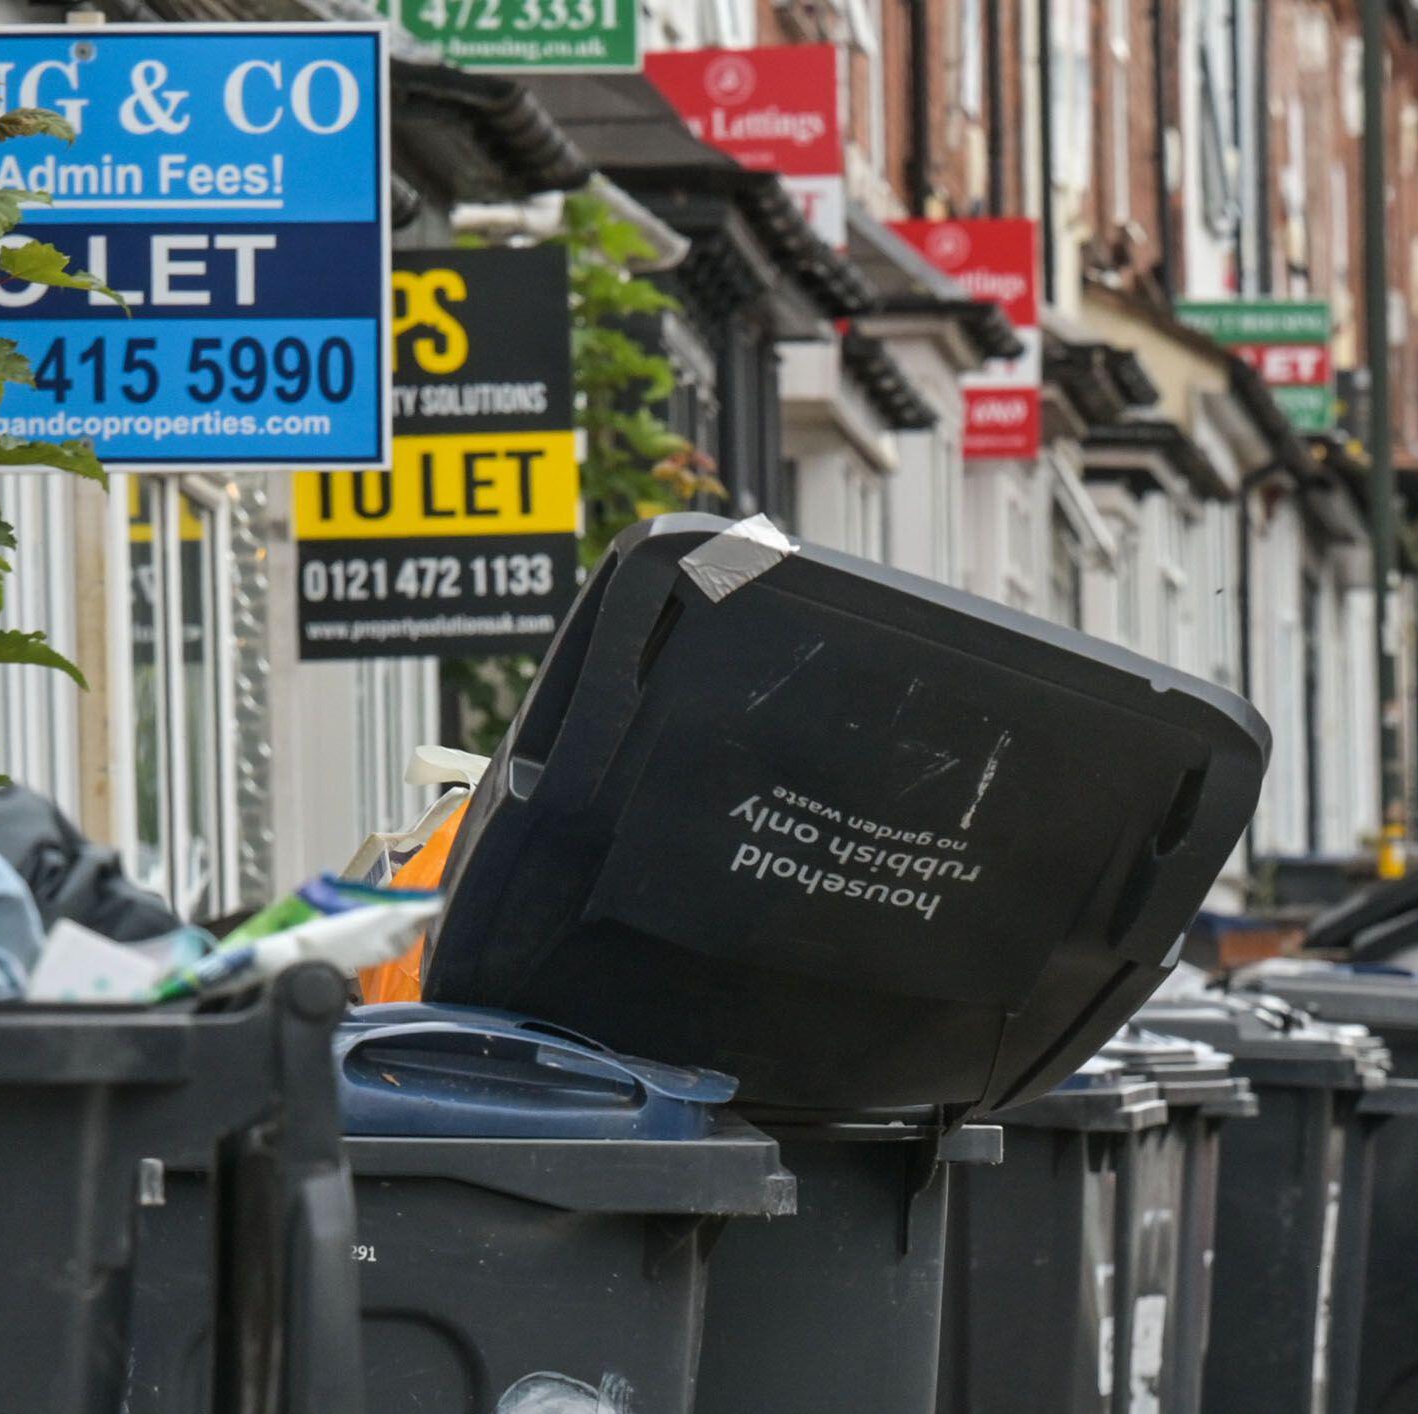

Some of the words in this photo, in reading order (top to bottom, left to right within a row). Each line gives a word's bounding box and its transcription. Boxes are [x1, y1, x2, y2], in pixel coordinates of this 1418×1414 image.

[119, 59, 191, 135] &
[223, 59, 360, 135] CO
[712, 107, 825, 147] Lettings
[159, 154, 283, 195] Fees!
[88, 234, 277, 306] LET
[33, 336, 160, 404] 415
[186, 336, 354, 404] 5990
[419, 381, 548, 416] SOLUTIONS
[420, 450, 545, 519] LET
[302, 558, 388, 602] 0121
[394, 555, 462, 599] 472
[470, 552, 553, 597] 1133
[728, 794, 820, 844] only
[771, 784, 842, 824] waste
[847, 814, 933, 846] garden
[936, 837, 968, 851] no
[730, 842, 942, 921] household
[828, 836, 982, 882] rubbish
